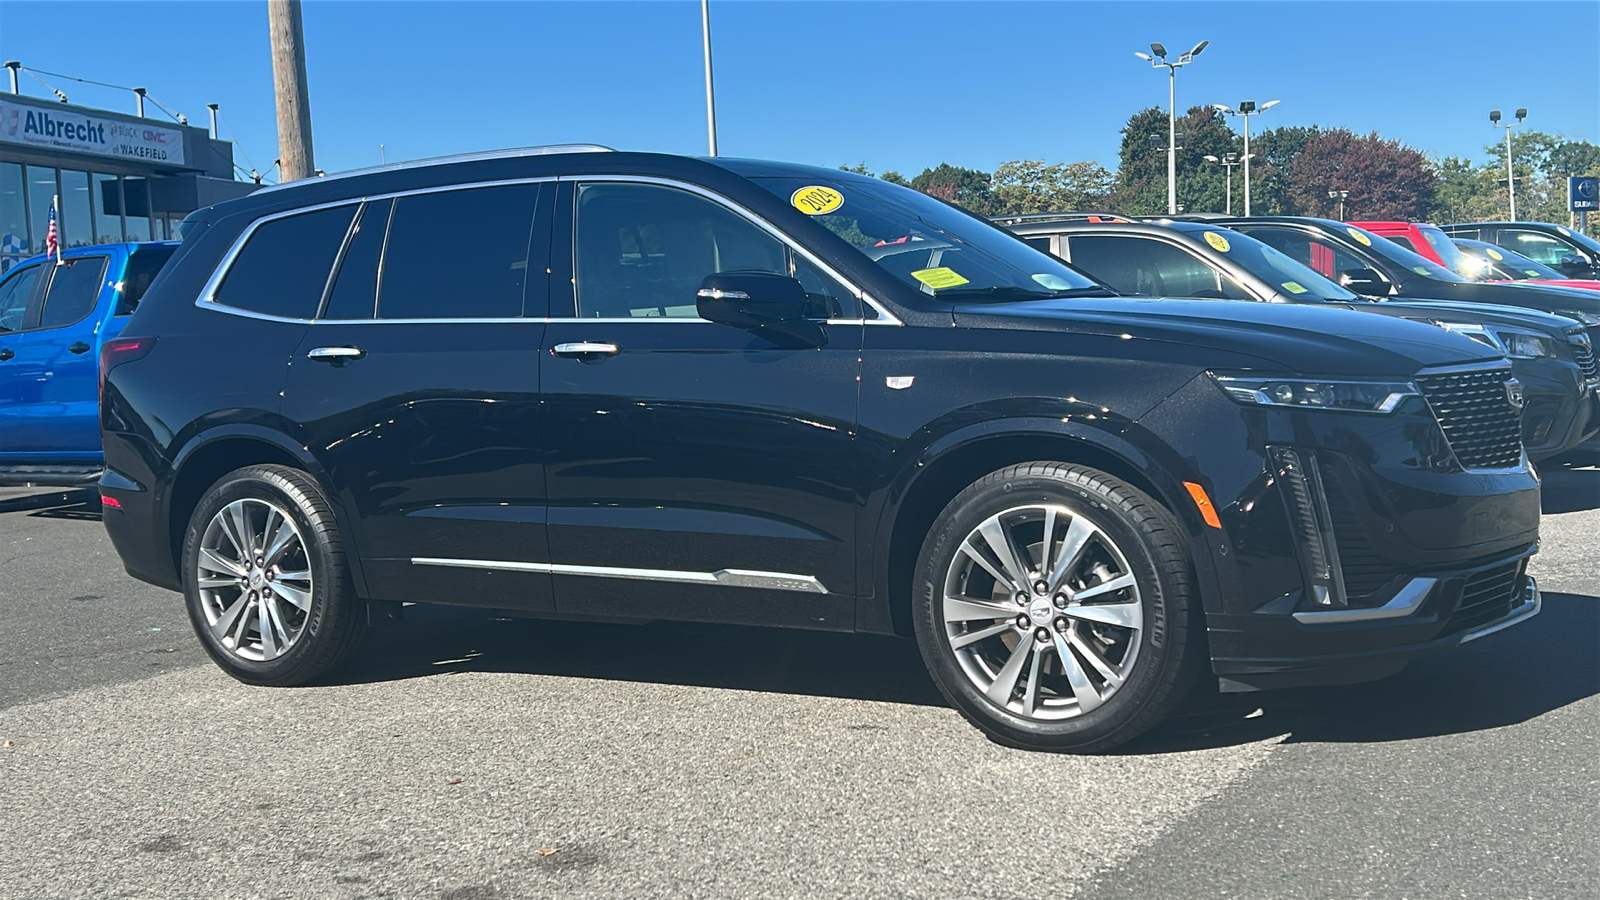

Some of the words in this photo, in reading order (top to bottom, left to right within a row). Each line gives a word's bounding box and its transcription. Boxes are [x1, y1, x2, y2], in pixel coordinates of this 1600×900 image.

[24, 110, 106, 144] Albrecht
[119, 125, 138, 138] BUICK
[142, 130, 166, 143] GMC
[112, 144, 119, 154] of
[120, 144, 167, 160] WAKEFIELD
[800, 188, 837, 212] 2024
[1144, 562, 1166, 646] MICHELIN
